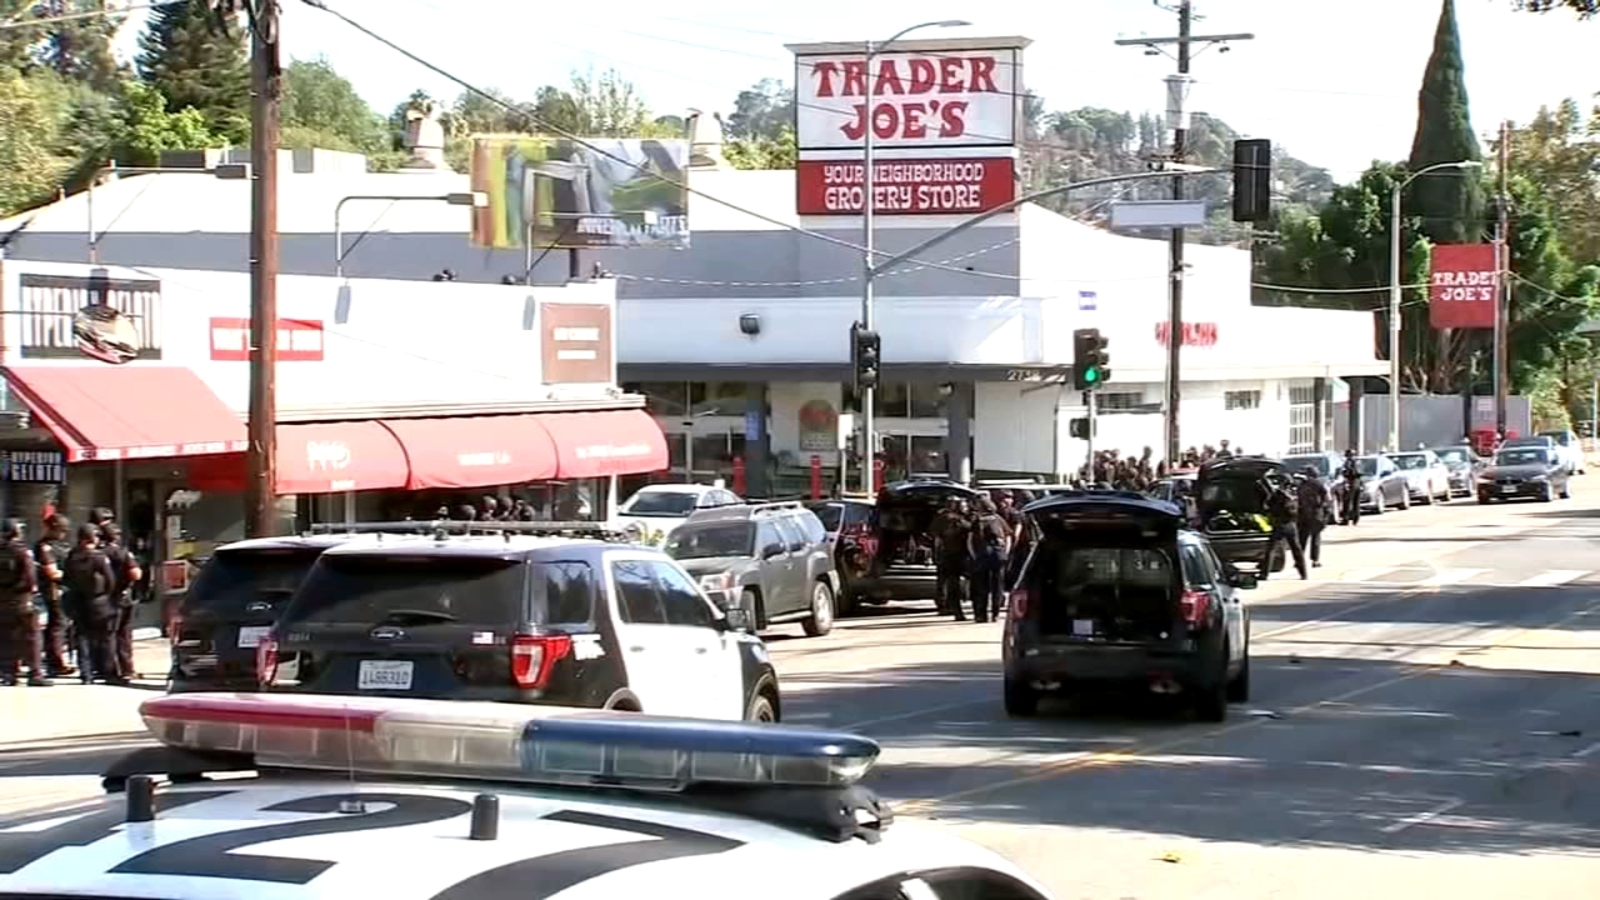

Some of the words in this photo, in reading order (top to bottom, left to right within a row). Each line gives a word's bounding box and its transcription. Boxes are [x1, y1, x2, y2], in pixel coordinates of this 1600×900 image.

[811, 57, 998, 96] TRADER
[840, 100, 969, 140] JOE'S
[824, 165, 865, 183] YOUR
[825, 186, 912, 210] GROERY
[918, 184, 980, 208] STORE
[1440, 286, 1492, 301] JOE'S
